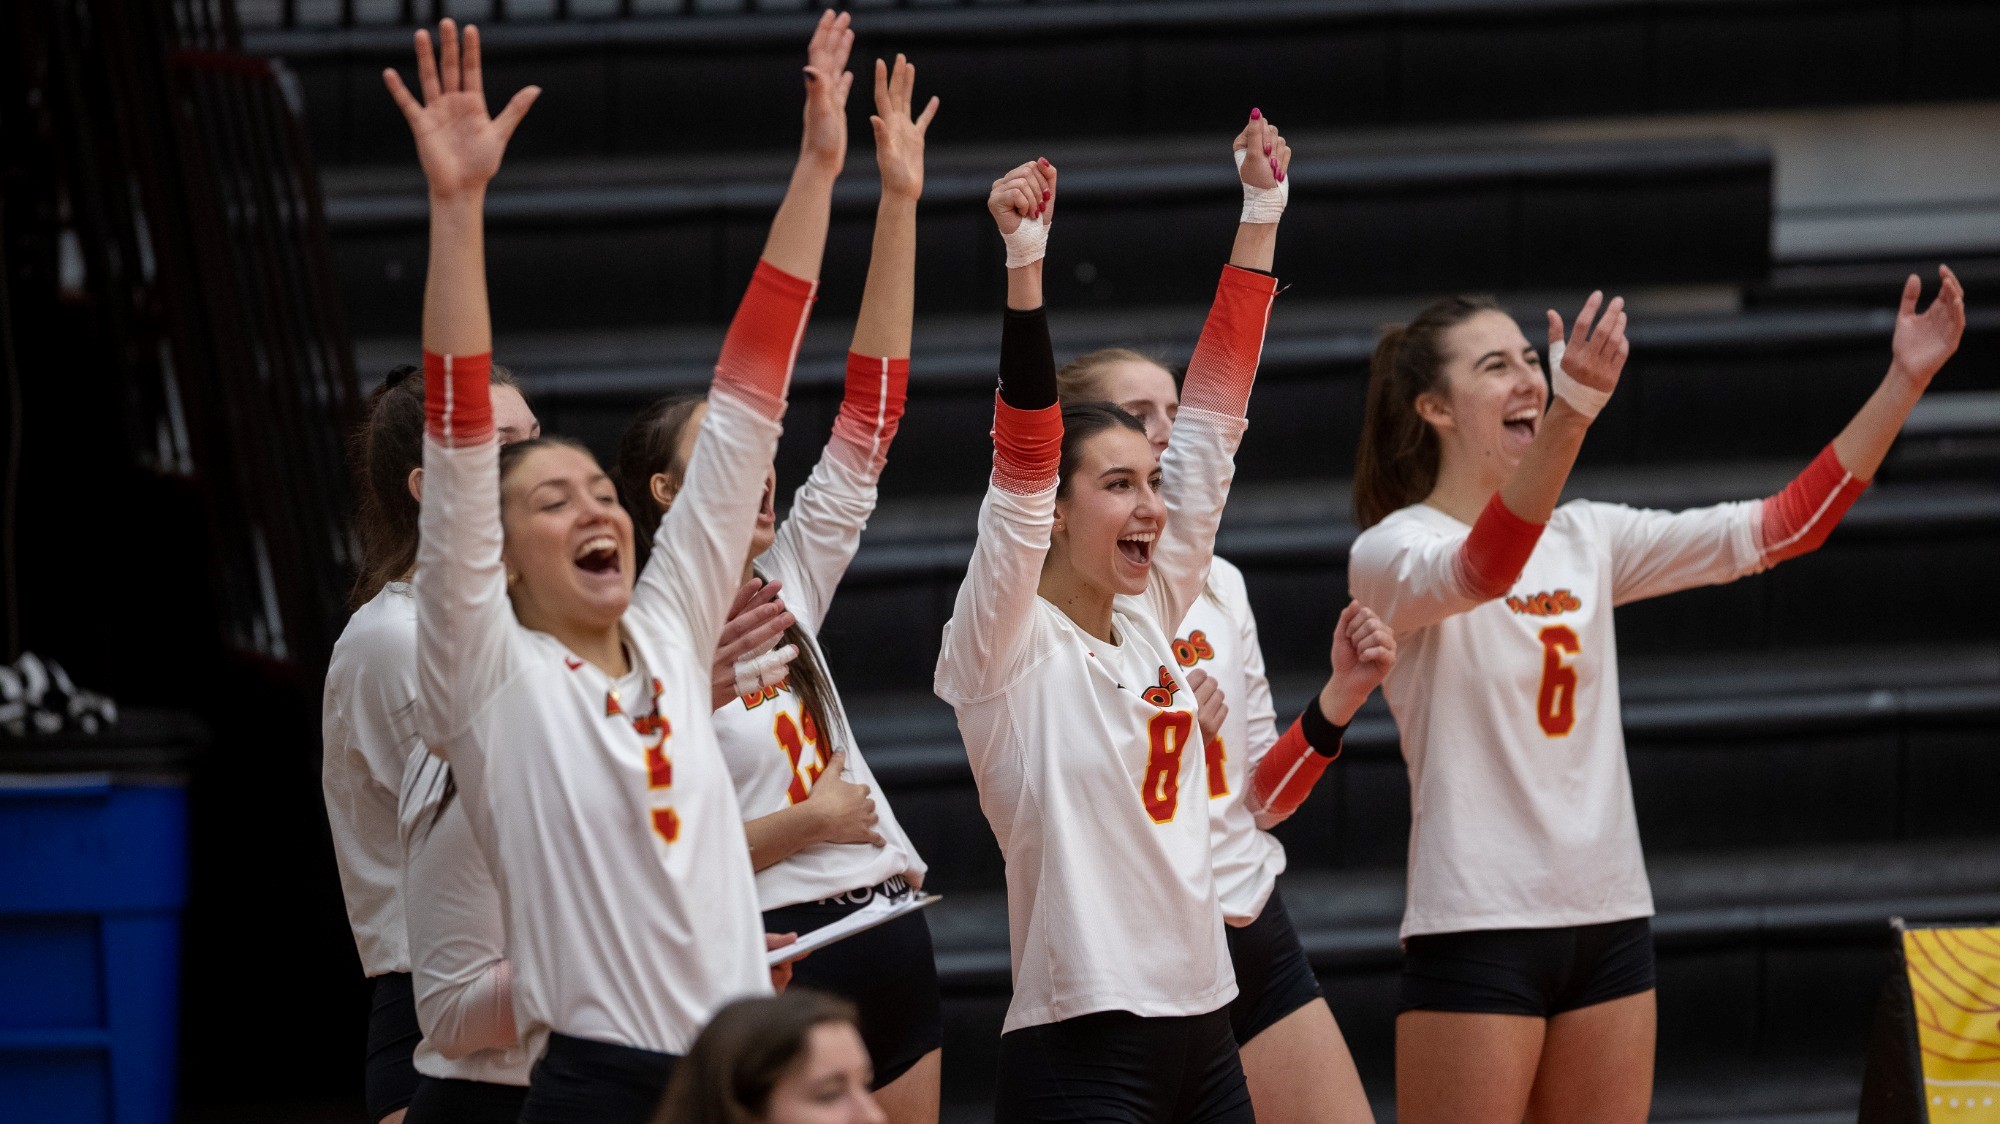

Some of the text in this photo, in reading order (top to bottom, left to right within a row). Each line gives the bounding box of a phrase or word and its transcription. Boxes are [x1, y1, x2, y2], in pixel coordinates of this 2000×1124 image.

[1171, 629, 1215, 667] OS
[1536, 623, 1582, 738] 6
[1140, 708, 1194, 825] 8
